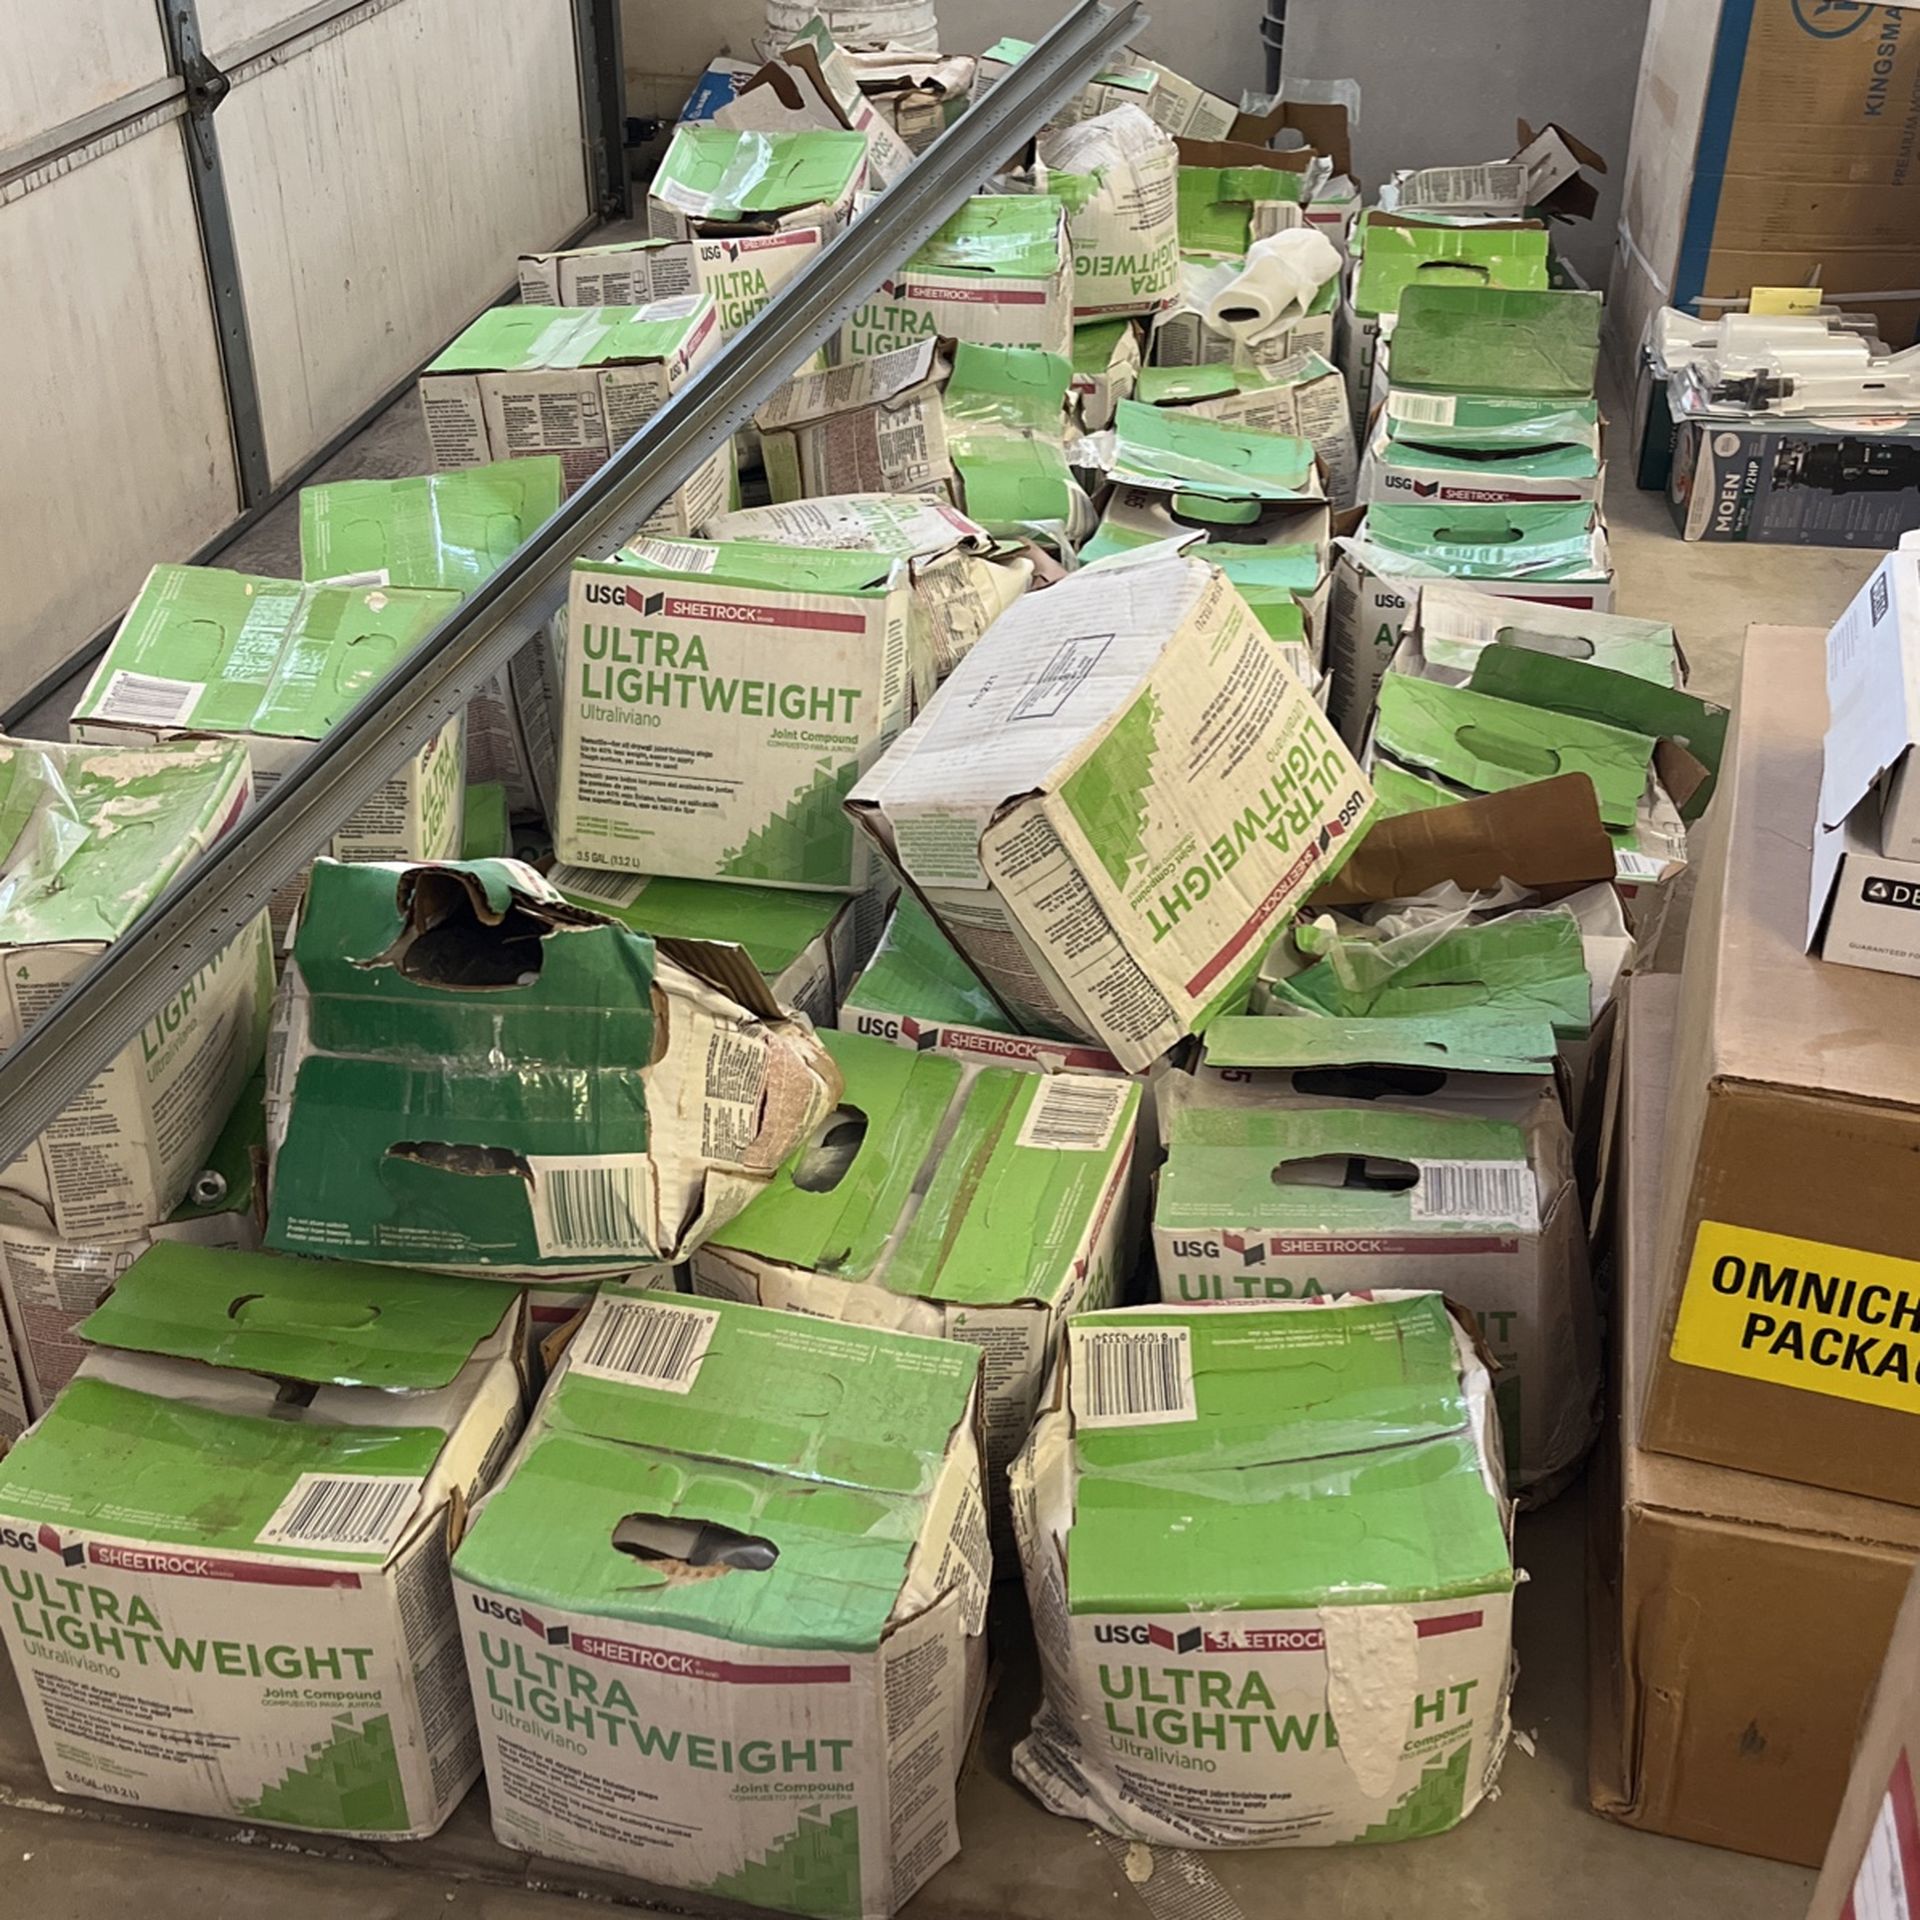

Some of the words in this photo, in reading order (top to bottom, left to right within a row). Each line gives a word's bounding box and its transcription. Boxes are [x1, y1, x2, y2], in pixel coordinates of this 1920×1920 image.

[700, 245, 721, 261] USG
[852, 304, 938, 335] ULTRA
[1385, 475, 1412, 491] USG
[1715, 472, 1742, 532] MOEN
[585, 583, 626, 607] USG
[1375, 593, 1406, 608] USG
[583, 624, 710, 672] ULTRA
[581, 663, 862, 724] LIGHTWEIGHT
[580, 702, 662, 729] Ultraliviano
[770, 727, 798, 740] Joint
[800, 730, 859, 745] Compound
[1264, 748, 1347, 854] ULTRA
[1338, 789, 1366, 827] USG
[1150, 714, 1328, 945] LIGHTWEIGHT
[16, 965, 30, 980] 4
[857, 1016, 899, 1039] USG
[1172, 1240, 1221, 1258] USG
[954, 1311, 967, 1326] 4
[1740, 1311, 1920, 1387] PACKA
[0, 1564, 164, 1632] ULTRA
[472, 1594, 523, 1627] USG
[12, 1601, 374, 1681] LIGHTWEIGHT
[1094, 1624, 1149, 1645] USG
[23, 1639, 121, 1679] Ultraliviano
[478, 1630, 640, 1718] ULTRA
[263, 1687, 298, 1699] Joint
[303, 1688, 382, 1701] Compound
[1098, 1664, 1276, 1711] ULTRA
[486, 1667, 853, 1775] LIGHTWEIGHT
[490, 1703, 589, 1757] Ultraliviano
[1403, 1718, 1474, 1752] Compound
[1109, 1734, 1217, 1773] Ultraliviano
[731, 1782, 770, 1794] Joint
[773, 1781, 855, 1796] Compound
